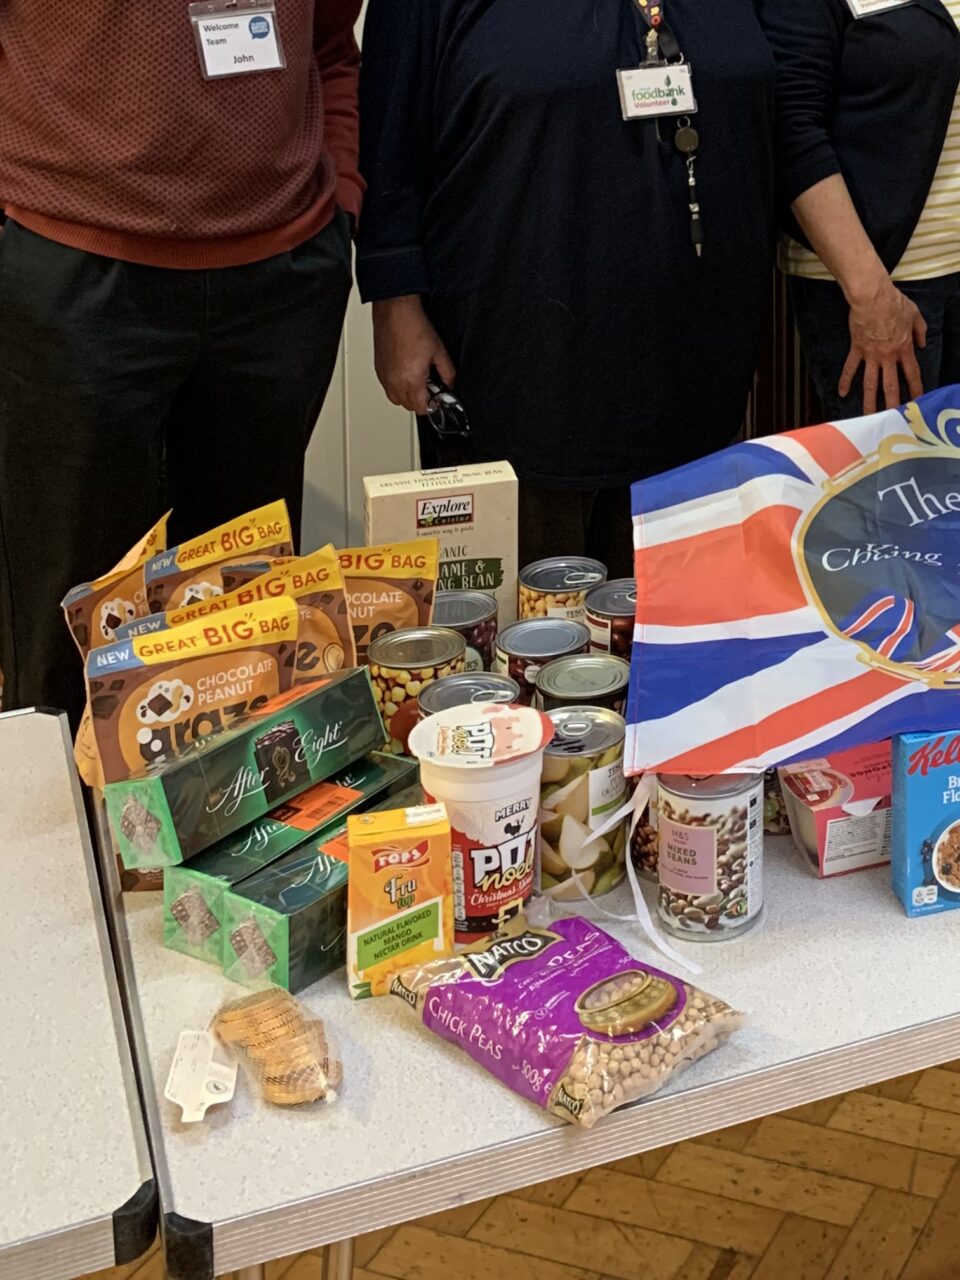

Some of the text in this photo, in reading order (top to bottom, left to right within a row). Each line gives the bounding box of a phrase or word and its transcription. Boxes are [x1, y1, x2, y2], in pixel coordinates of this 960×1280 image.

[203, 23, 239, 32] Welcome
[206, 37, 227, 46] Team
[233, 55, 255, 64] John
[632, 85, 686, 101] foodbank
[420, 499, 470, 517] Explore
[434, 515, 470, 525] Cuisine
[151, 521, 283, 572] NEW GREAT BIG BAG
[391, 555, 427, 569] BAG
[462, 572, 495, 590] BEAN
[128, 568, 330, 638] NEW GREAT BIG BAG
[96, 616, 290, 667] NEW GREAT BIG BAG
[196, 658, 273, 691] CHOCOLATE
[197, 679, 255, 706] PEANUT
[206, 721, 349, 817] After Eight
[495, 797, 532, 822] MERRY
[672, 829, 689, 841] M&S
[378, 848, 422, 867] TOPS
[666, 851, 698, 866] BEANS
[667, 843, 697, 858] MIXED
[481, 849, 533, 892] noel
[384, 874, 417, 904] Fru
[470, 887, 516, 905] Christmas
[363, 909, 432, 947] NATURAL FLAVORED
[383, 929, 412, 946] MANGO
[374, 931, 424, 961] NECTAR DRINK
[468, 935, 543, 975] NATCO
[391, 978, 417, 1005] NATCO
[429, 997, 504, 1060] CHICK PEAS
[521, 1060, 545, 1092] 500g
[556, 1089, 581, 1114] NATCO
